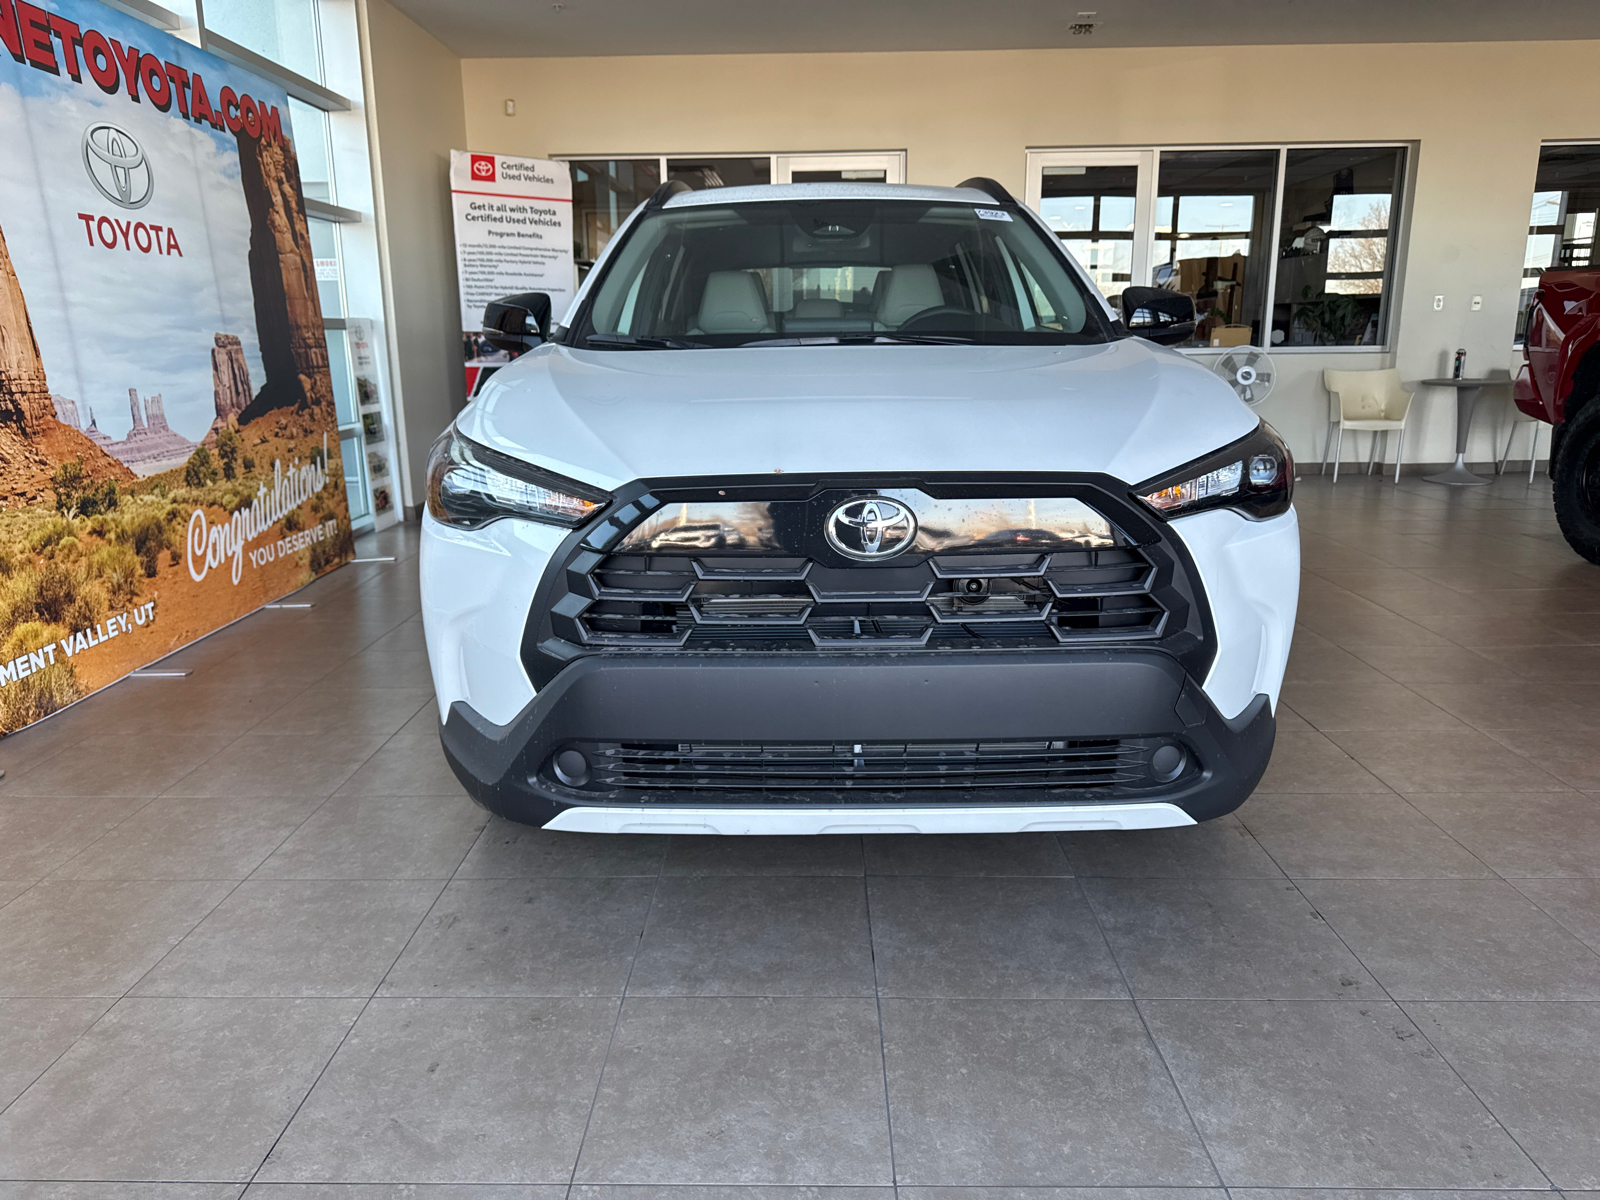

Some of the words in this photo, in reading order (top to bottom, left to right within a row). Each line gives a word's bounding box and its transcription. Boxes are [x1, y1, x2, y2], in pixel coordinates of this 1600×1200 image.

[500, 161, 535, 173] Certified
[501, 172, 522, 181] Used
[523, 174, 554, 184] Vehicles
[469, 202, 486, 211] Get
[488, 203, 495, 212] it
[496, 204, 507, 213] all
[509, 205, 528, 214] with
[529, 206, 556, 218] Toyota
[465, 213, 504, 223] Certified
[505, 216, 526, 225] Used
[528, 217, 562, 227] Vehicles
[78, 212, 183, 257] TOYOTA
[488, 230, 516, 238] Program
[517, 231, 543, 240] Benefits
[187, 431, 330, 585] Congratulations!
[249, 543, 275, 568] YOU
[277, 524, 326, 558] DESERVE
[326, 519, 338, 539] IT!
[0, 643, 57, 688] MENT
[60, 612, 133, 658] VALLEY,
[134, 601, 156, 628] UT
